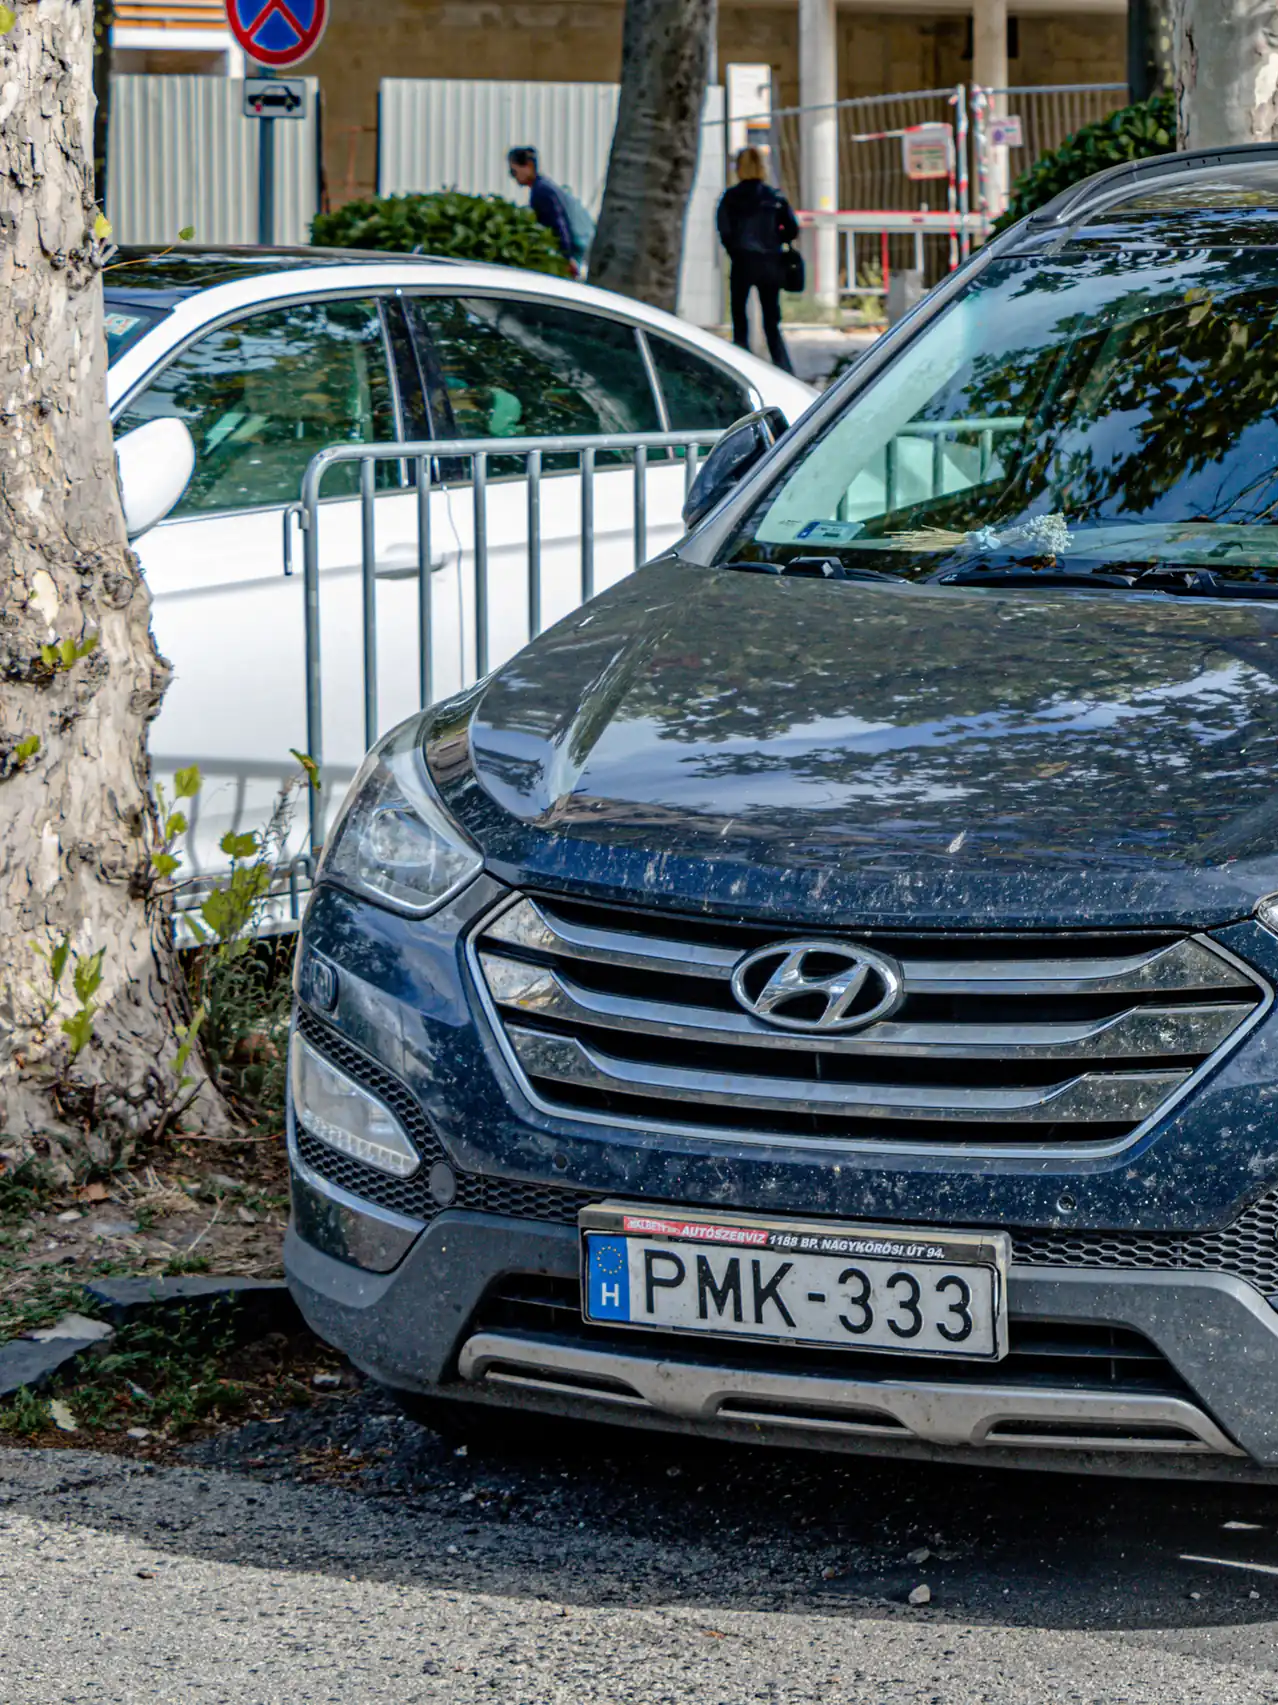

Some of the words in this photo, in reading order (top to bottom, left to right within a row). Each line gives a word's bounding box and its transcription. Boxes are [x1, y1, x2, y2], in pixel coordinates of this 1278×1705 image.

[769, 1234, 798, 1248] 1188
[800, 1237, 819, 1250] BP.
[926, 1246, 946, 1259] 94.
[601, 1282, 620, 1308] H
[644, 1248, 973, 1342] PMK-333
